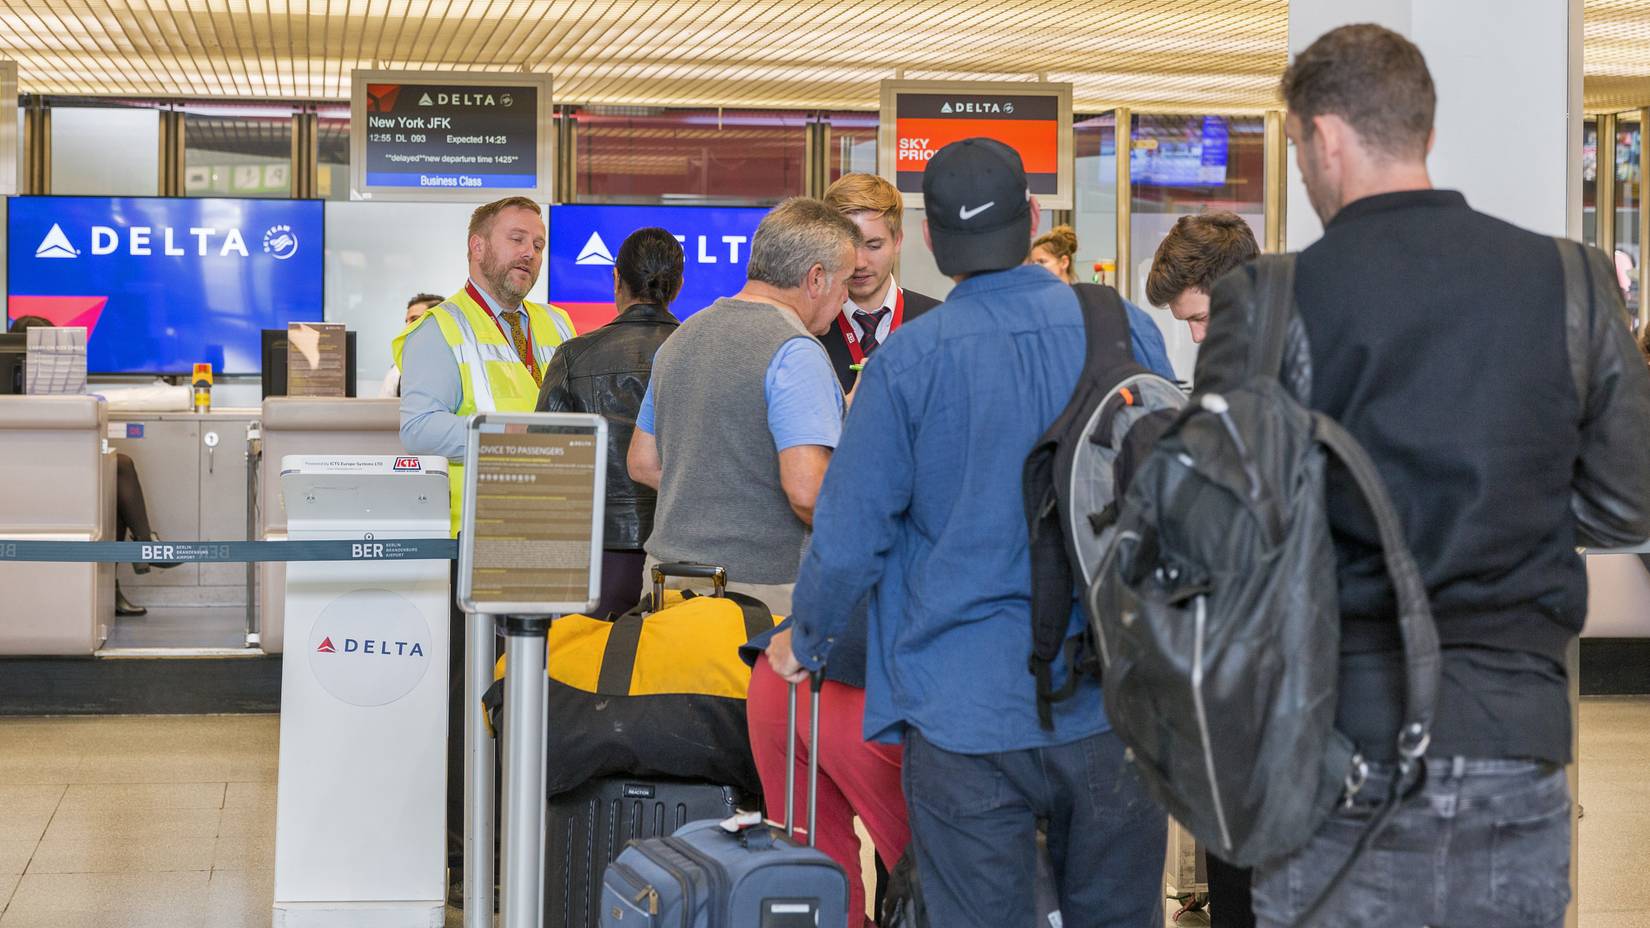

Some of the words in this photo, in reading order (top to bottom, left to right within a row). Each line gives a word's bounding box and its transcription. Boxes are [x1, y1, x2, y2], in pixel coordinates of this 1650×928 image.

[438, 93, 496, 106] DELTA
[955, 102, 1000, 113] DELTA
[369, 116, 395, 128] New
[397, 117, 425, 129] York
[427, 117, 451, 129] JFK
[369, 133, 392, 142] 12:55
[395, 134, 407, 143] DL
[410, 134, 426, 143] 093
[446, 135, 483, 144] Expected
[485, 136, 507, 144] 14:25
[899, 138, 930, 149] SKY
[441, 155, 476, 164] departure
[477, 155, 493, 163] time
[899, 149, 939, 161] PRIO
[420, 175, 458, 186] Business
[459, 175, 482, 187] Class
[91, 226, 250, 257] DELTA
[478, 445, 504, 455] DVICE
[506, 446, 517, 455] TO
[517, 446, 565, 456] PASSENGERS
[396, 457, 418, 468] ICTS
[141, 545, 174, 560] BER
[352, 543, 384, 558] BER
[344, 638, 424, 657] DELTA
